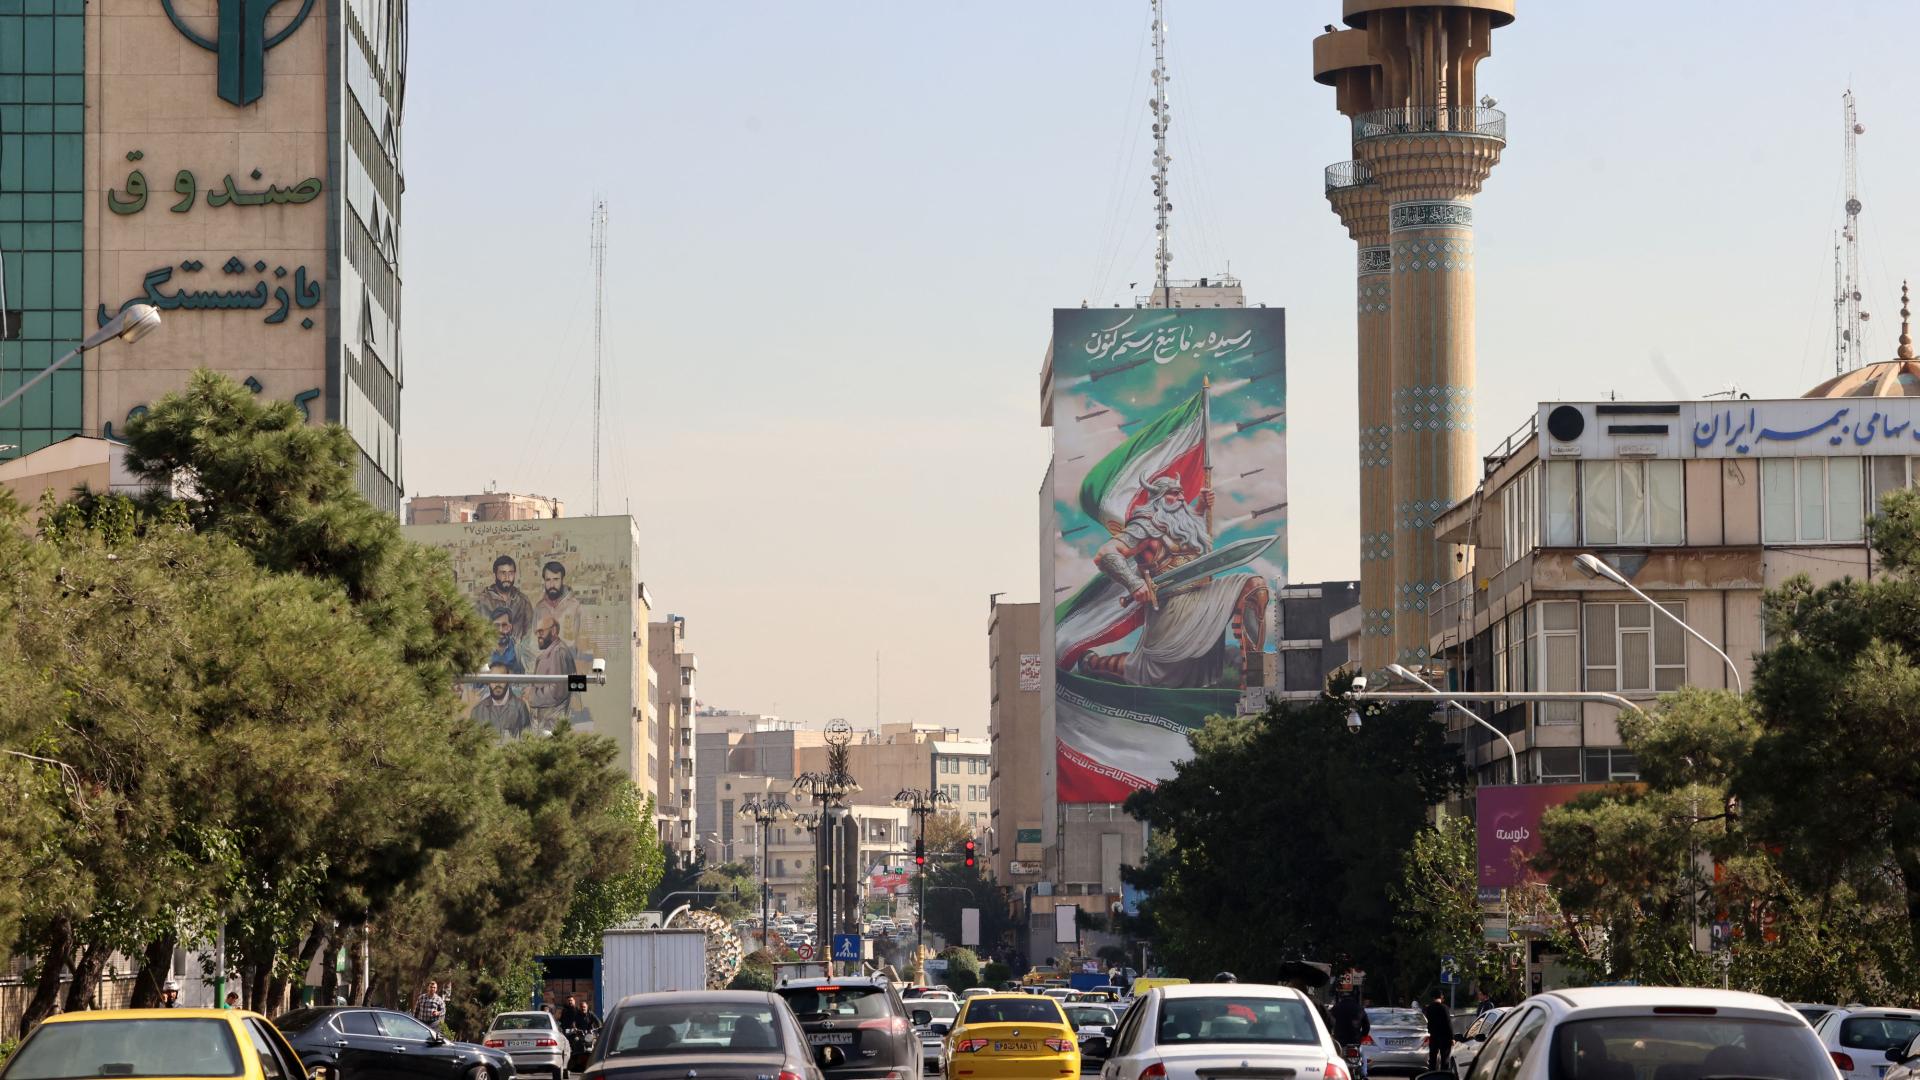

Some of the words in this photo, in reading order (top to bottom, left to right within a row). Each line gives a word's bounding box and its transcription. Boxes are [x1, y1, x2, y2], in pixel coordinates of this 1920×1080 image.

[107, 149, 322, 216] صندوق
[1085, 313, 1134, 361] کنون
[1111, 330, 1154, 361] رستم
[1153, 326, 1180, 364] تیغ
[1191, 339, 1206, 358] به
[1205, 329, 1252, 358] رسیده
[1693, 407, 1755, 454] ایران
[1755, 407, 1850, 446] بیمه
[1853, 411, 1910, 446] سهامی
[1496, 826, 1530, 843] دلوسه
